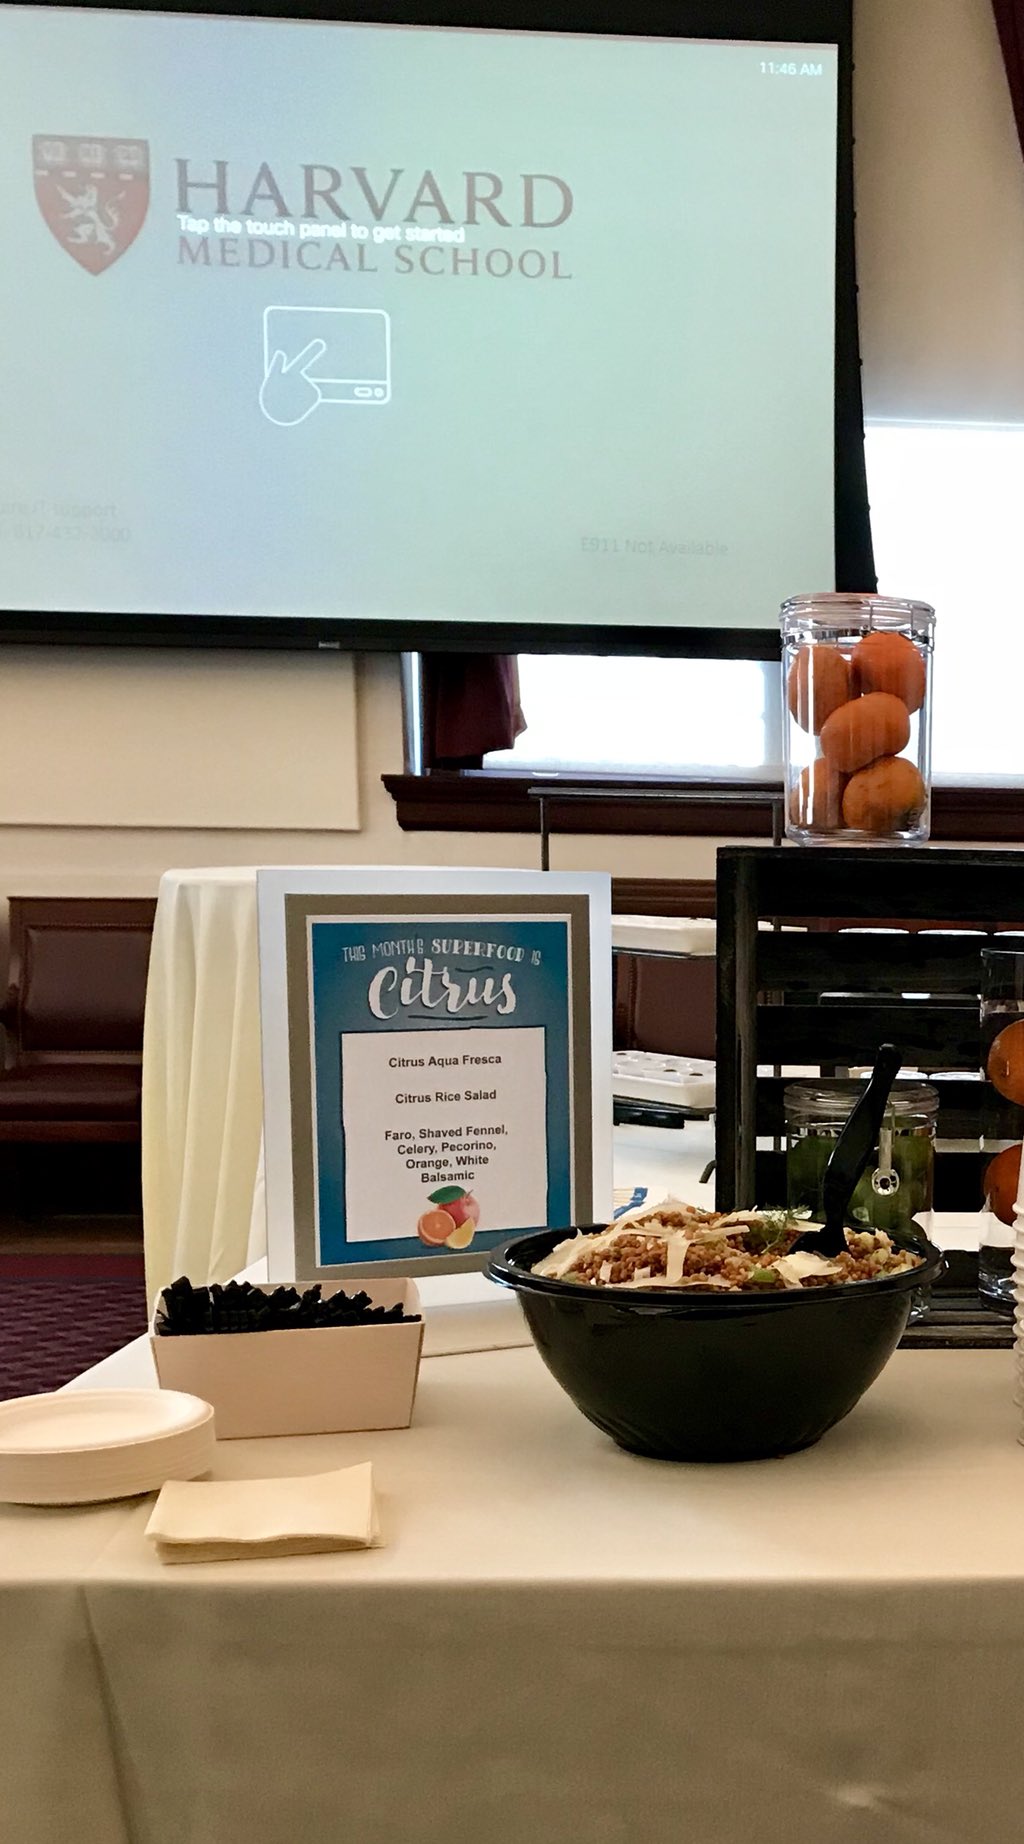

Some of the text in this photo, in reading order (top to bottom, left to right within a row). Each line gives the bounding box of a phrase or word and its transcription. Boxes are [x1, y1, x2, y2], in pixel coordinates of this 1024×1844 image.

[800, 63, 823, 76] AM
[174, 157, 574, 229] HARVARD
[176, 213, 466, 243] Tap the touch panel to get started
[176, 235, 573, 280] MEDICAL SCHOOL
[624, 537, 654, 555] Not
[659, 540, 728, 557] Available
[341, 945, 367, 963] THIS
[431, 938, 526, 963] SUPERFOOD
[530, 949, 542, 966] IS
[368, 956, 517, 1020] Citrus
[388, 1055, 502, 1068] Citrus Aqua Fresca
[395, 1089, 497, 1104] Citrus Rice Salad
[384, 1124, 508, 1141] Faro, Shaved Fennel,
[397, 1141, 497, 1155] Celery, Pecorino,
[405, 1155, 489, 1170] Orange, White
[421, 1170, 475, 1183] Balsamic
